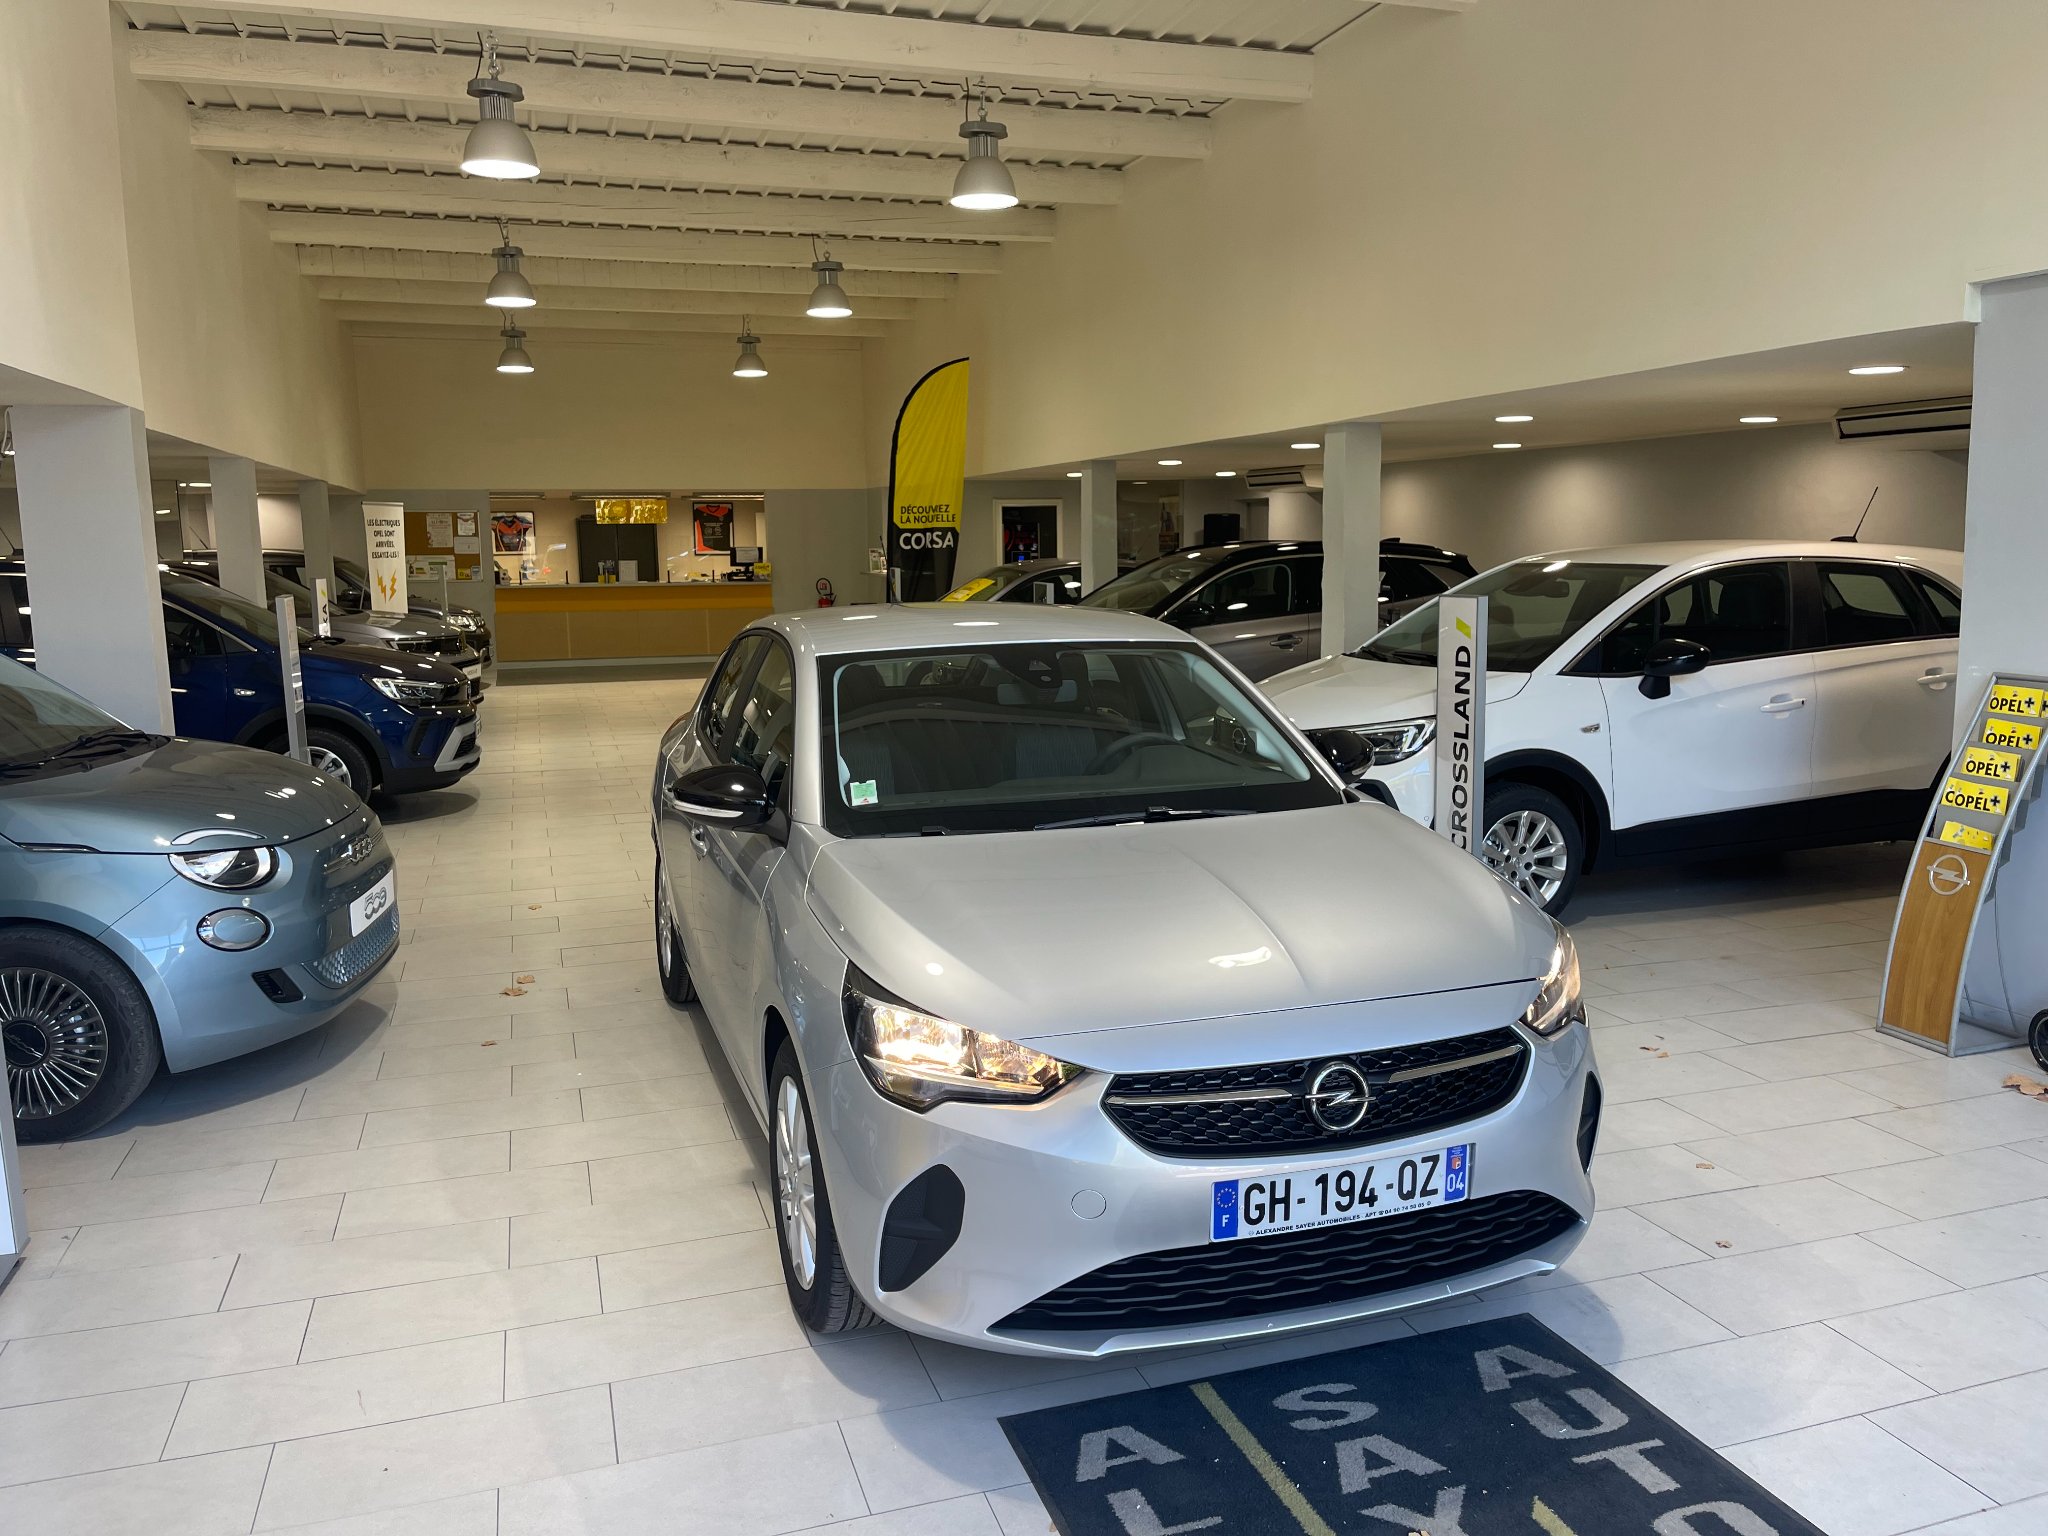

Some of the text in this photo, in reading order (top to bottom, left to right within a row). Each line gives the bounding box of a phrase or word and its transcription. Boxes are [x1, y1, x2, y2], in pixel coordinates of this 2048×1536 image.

[899, 531, 954, 550] CORSA
[900, 513, 956, 524] LA NOUELLE
[1451, 645, 1471, 851] CROSSLAND
[1221, 1154, 1465, 1228] F GH-194-QZ 04
[1255, 1225, 1293, 1235] ALEXANDRE
[1295, 1220, 1316, 1230] SAYER
[1317, 1214, 1360, 1226] AUTOMOBILES
[1075, 1425, 1224, 1536] AL
[1271, 1383, 1470, 1536] SAY
